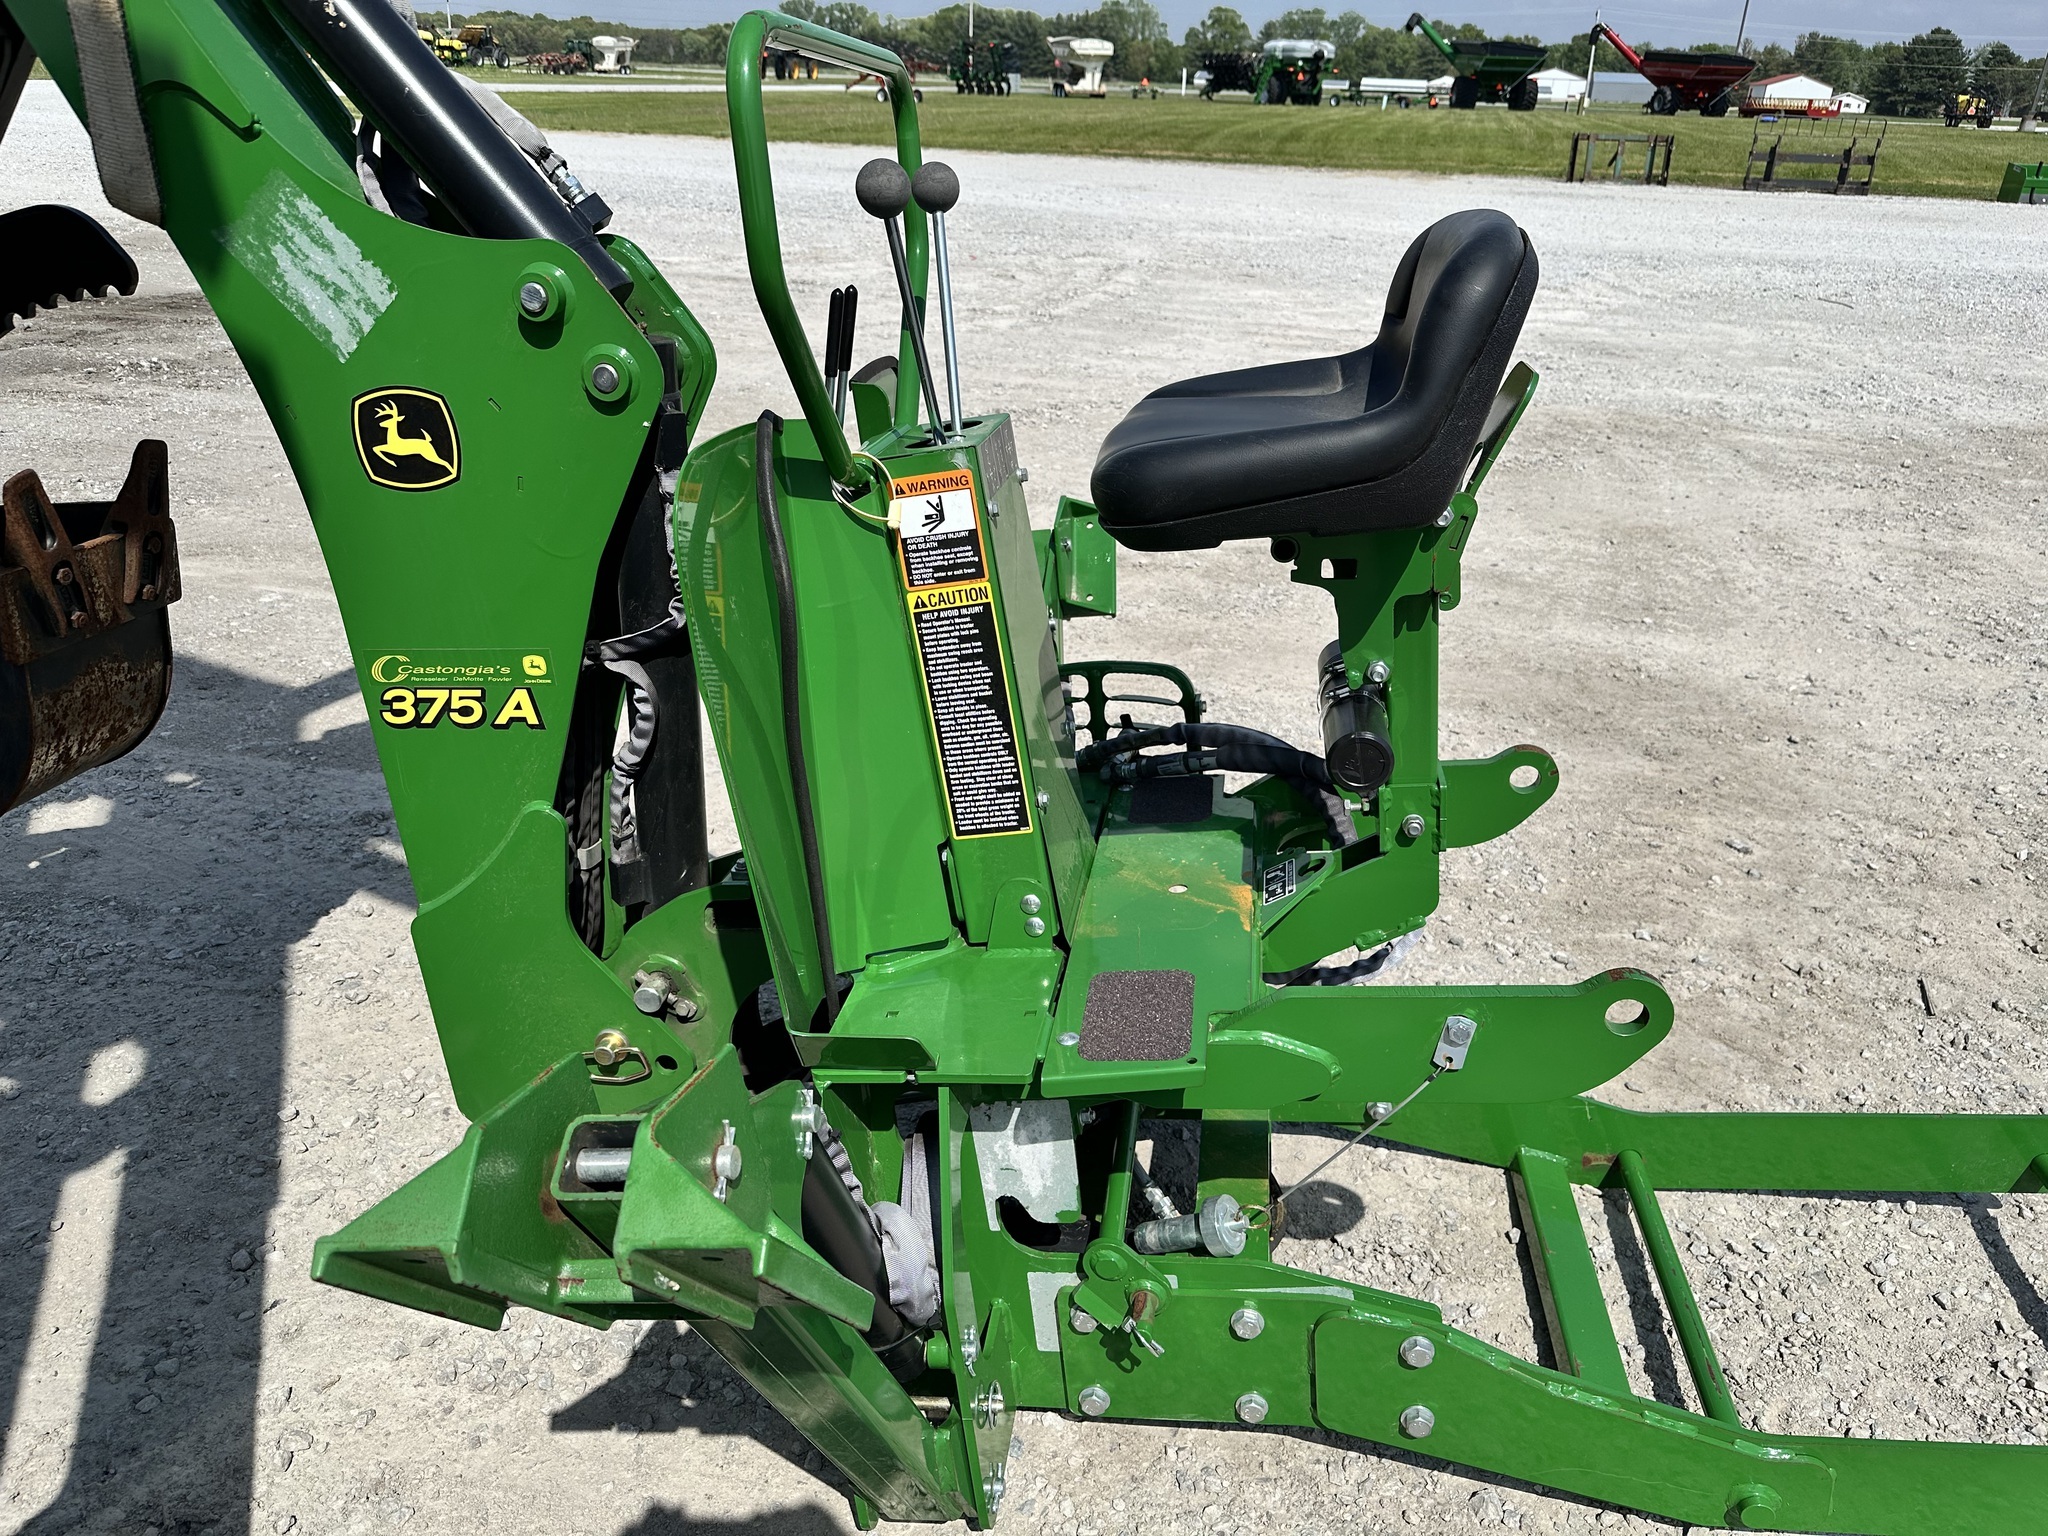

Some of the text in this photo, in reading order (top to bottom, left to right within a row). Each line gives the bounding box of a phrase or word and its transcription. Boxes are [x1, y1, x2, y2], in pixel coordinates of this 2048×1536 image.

[906, 475, 969, 493] WARNING
[928, 586, 988, 607] CAUTION
[922, 606, 984, 620] HELP AVOID INJURY
[397, 664, 511, 676] Castongia's
[380, 687, 546, 730] 375 A
